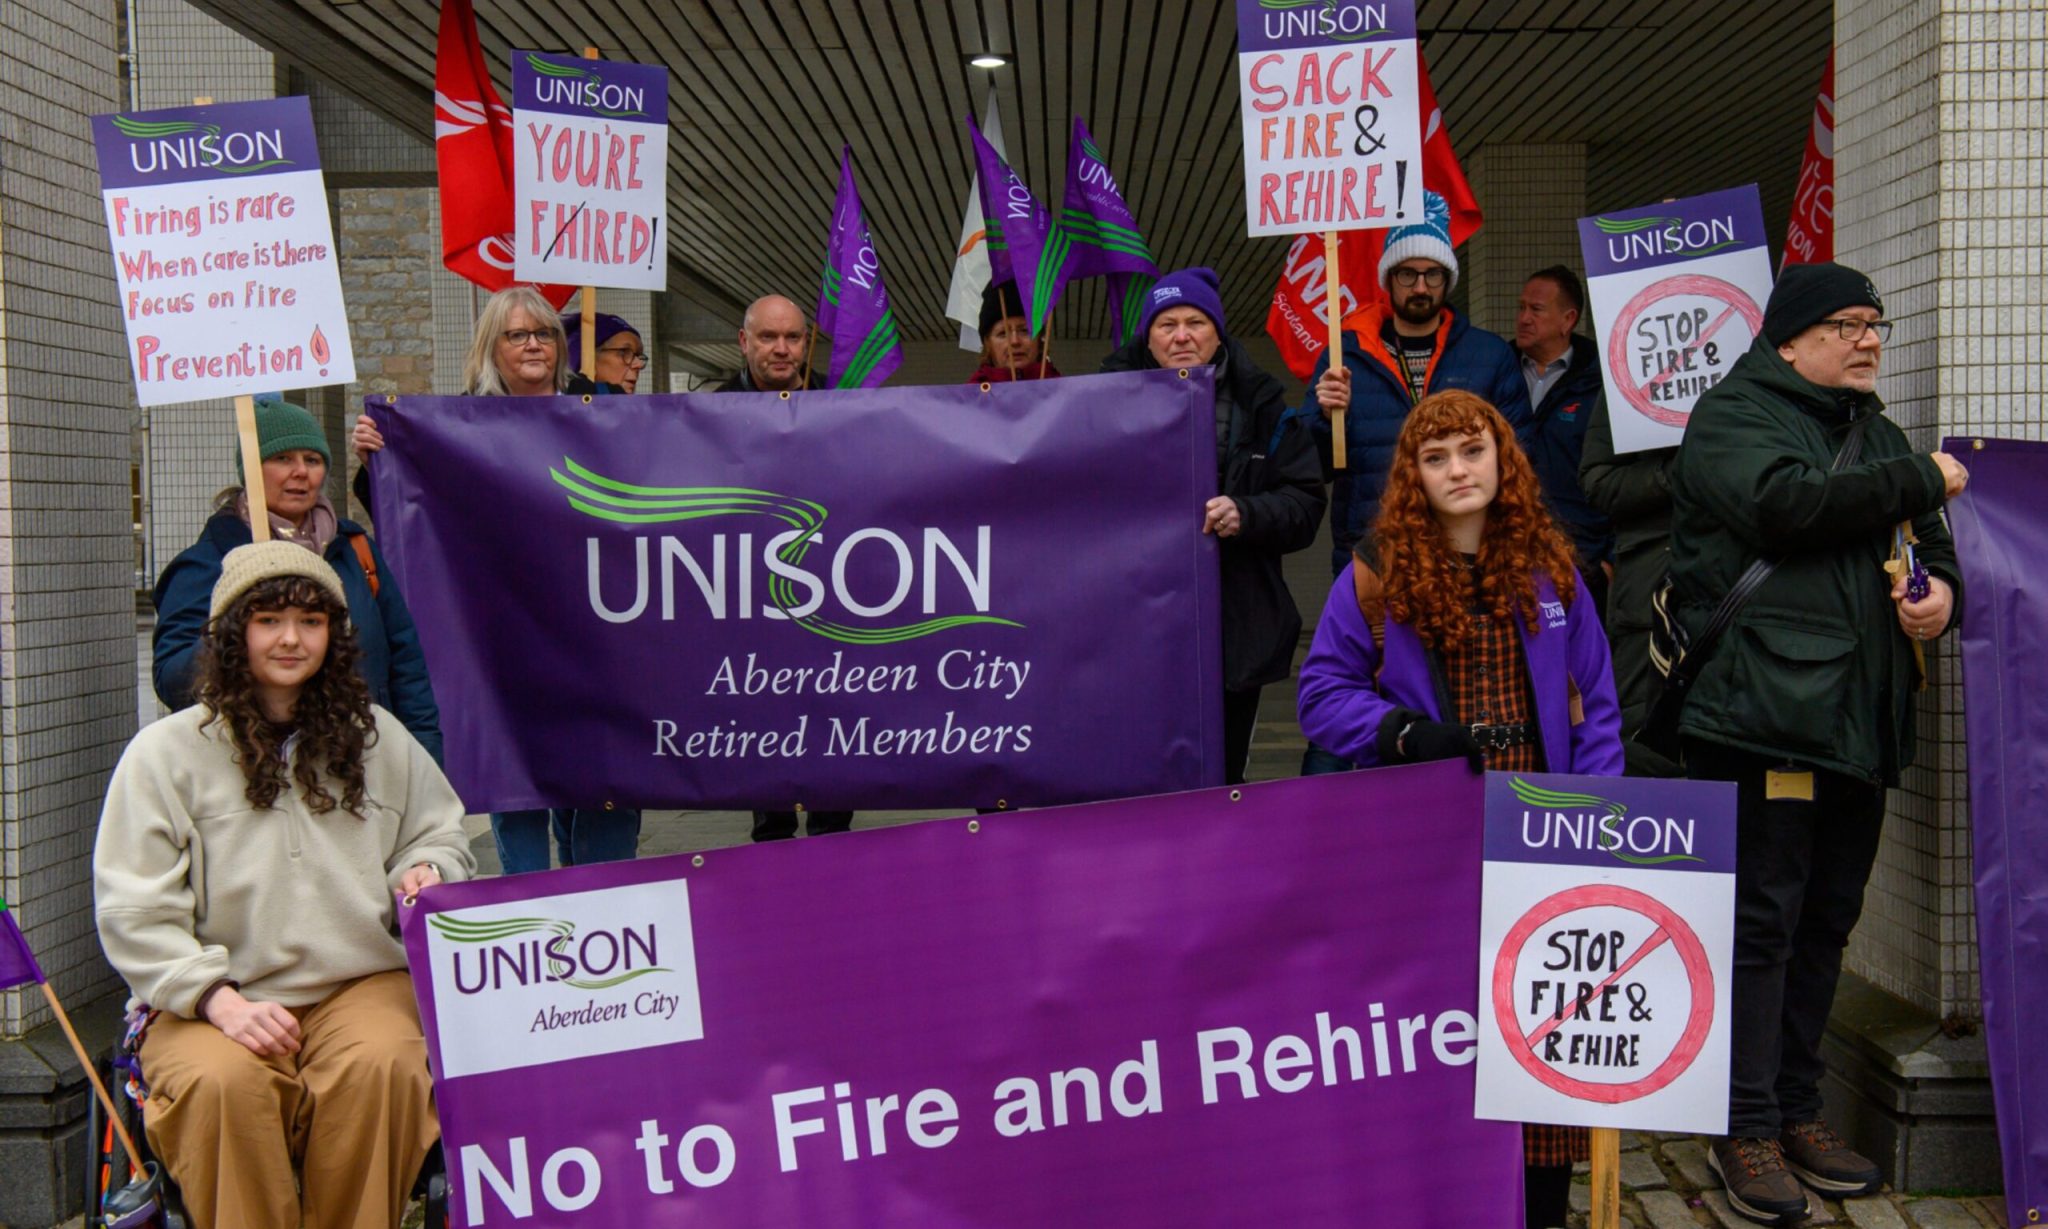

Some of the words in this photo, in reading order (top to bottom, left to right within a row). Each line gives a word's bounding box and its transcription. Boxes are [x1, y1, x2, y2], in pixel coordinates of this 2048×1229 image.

[1264, 3, 1386, 39] UNISON
[535, 77, 644, 112] UNISON
[1249, 47, 1397, 113] SACK
[130, 129, 284, 173] UNISON
[1260, 112, 1345, 161] FIRE
[1353, 104, 1387, 156] &
[527, 121, 645, 191] YOU'RE
[112, 196, 201, 238] Firing
[208, 195, 230, 225] is
[235, 191, 295, 223] rare
[1608, 215, 1735, 263] UNISON
[118, 249, 198, 283] When
[202, 249, 249, 272] care
[128, 290, 195, 320] Focus
[207, 290, 235, 309] on
[1636, 306, 1709, 353] STOP
[1640, 347, 1698, 378] FIRE
[1703, 341, 1722, 367] &
[586, 524, 991, 624] UNISON
[705, 650, 918, 697] Aberdeen
[937, 648, 1032, 699] City
[652, 715, 808, 759] Retired
[822, 710, 1033, 757] Members
[1521, 810, 1695, 855] UNISON
[453, 923, 658, 995] UNISON
[1543, 928, 1625, 973] STOP
[529, 999, 628, 1033] Aberdeen
[634, 990, 679, 1020] City
[1530, 980, 1620, 1022] FIRE
[1543, 1030, 1641, 1067] REHIRE
[460, 1136, 602, 1228] No
[635, 1118, 737, 1196] to
[771, 1081, 960, 1173] Fire
[993, 1039, 1164, 1138] and
[1196, 1002, 1478, 1105] Rehire
